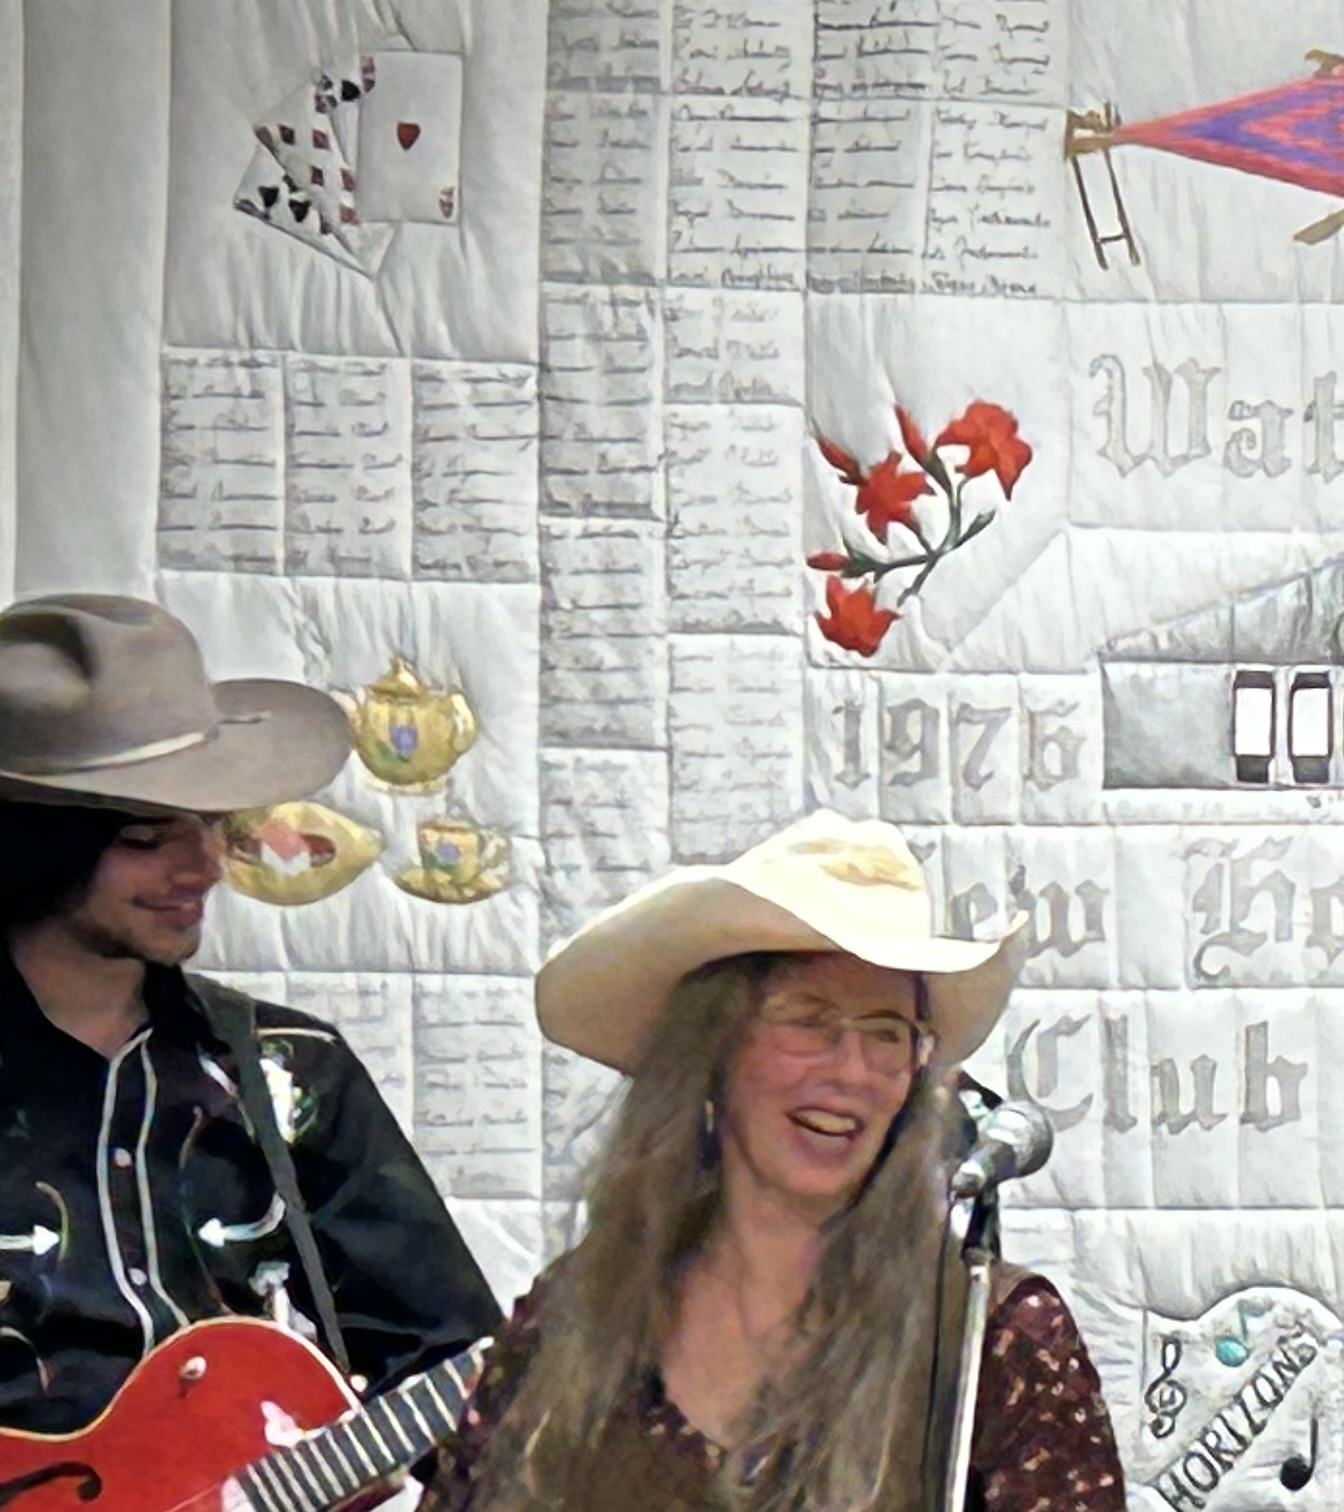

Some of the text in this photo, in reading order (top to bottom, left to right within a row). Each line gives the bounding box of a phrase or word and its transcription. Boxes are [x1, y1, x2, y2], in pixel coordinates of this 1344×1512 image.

[832, 698, 1088, 792] 1976
[907, 836, 1111, 959] ew
[1006, 1011, 1308, 1135] Club
